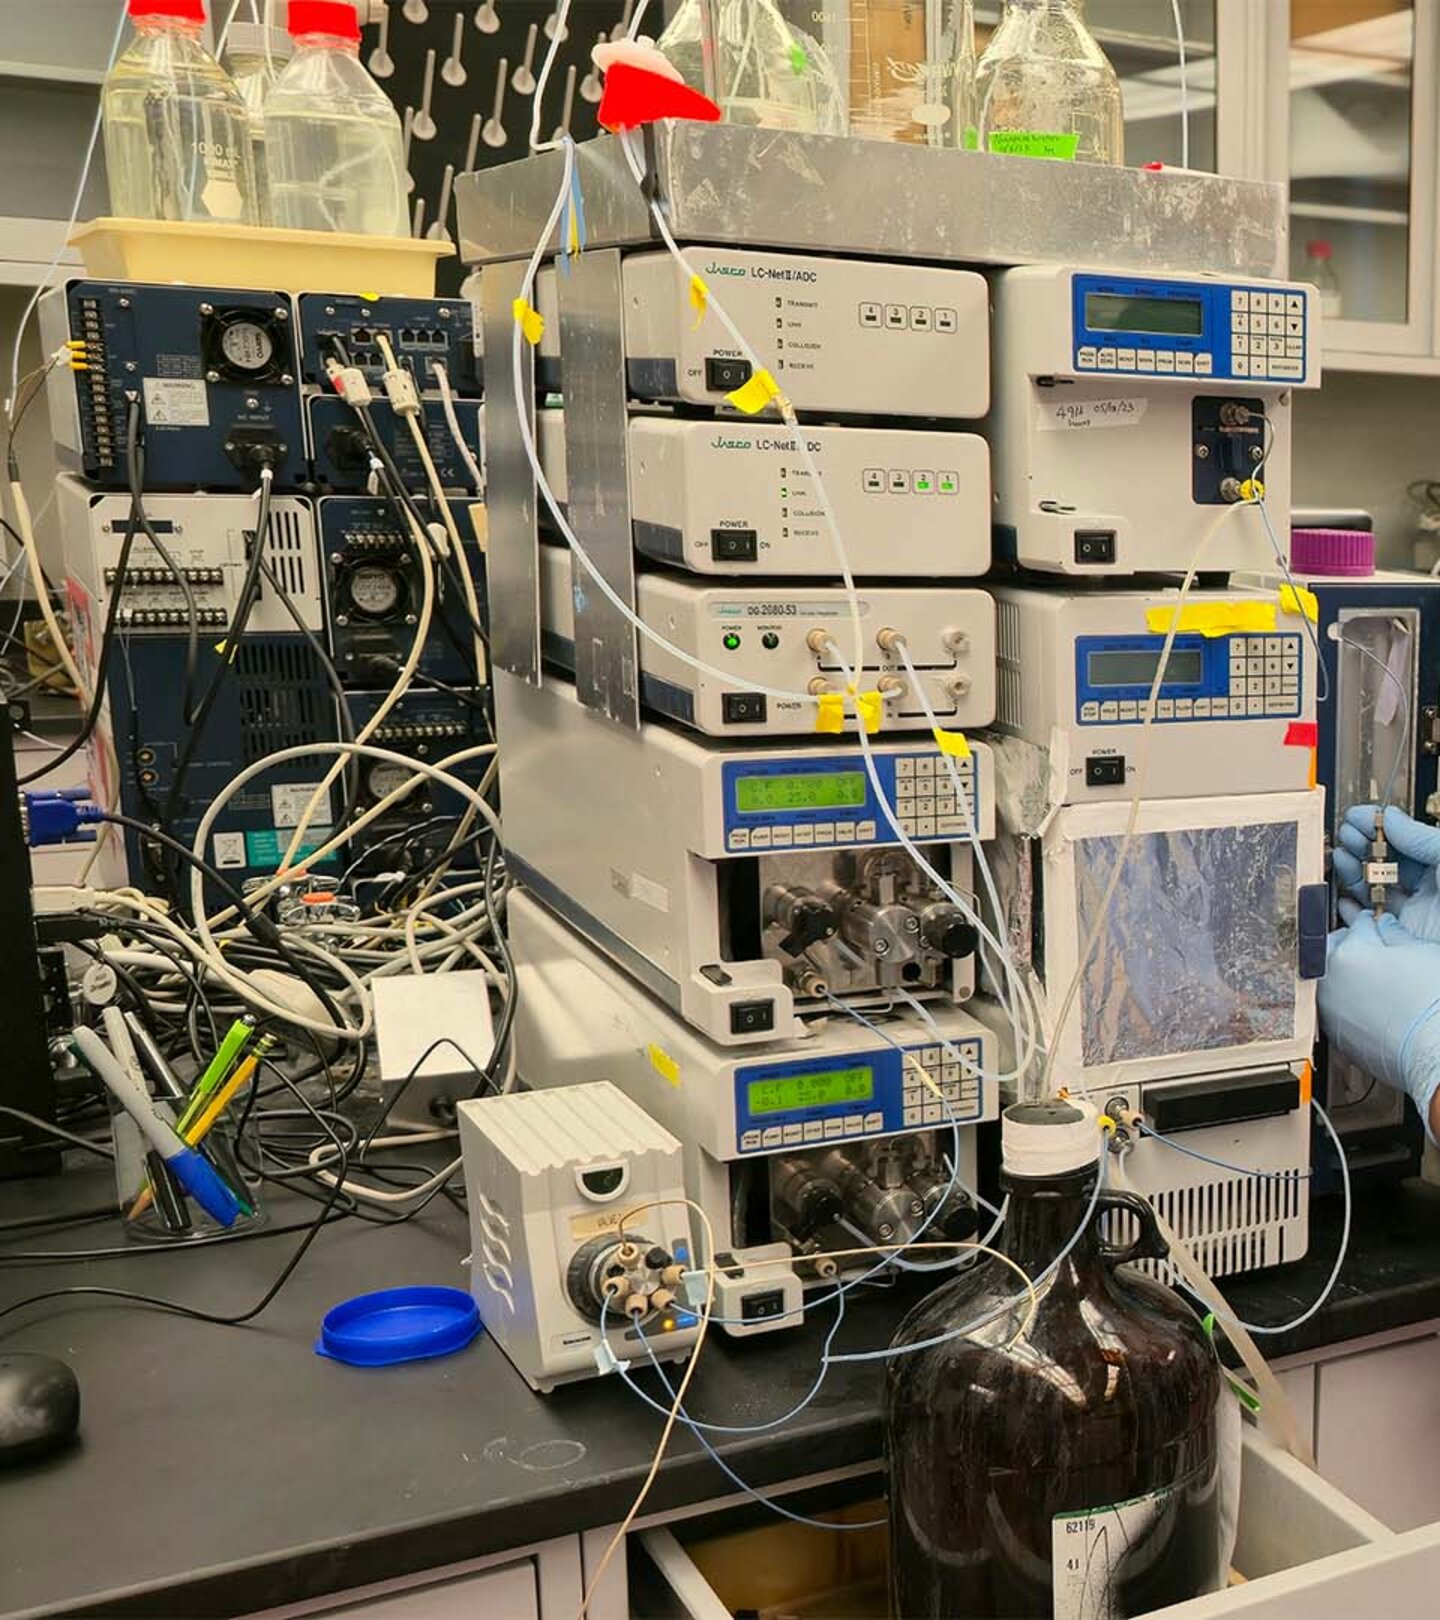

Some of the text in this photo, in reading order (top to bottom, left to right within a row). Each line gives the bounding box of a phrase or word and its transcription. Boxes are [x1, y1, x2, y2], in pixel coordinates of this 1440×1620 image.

[787, 341, 821, 349] COLLISION
[713, 348, 743, 357] POWER
[687, 368, 702, 377] OFF
[719, 520, 748, 528] POWER
[759, 541, 771, 549] ON
[1069, 767, 1083, 775] OFF
[1127, 765, 1136, 773] ON
